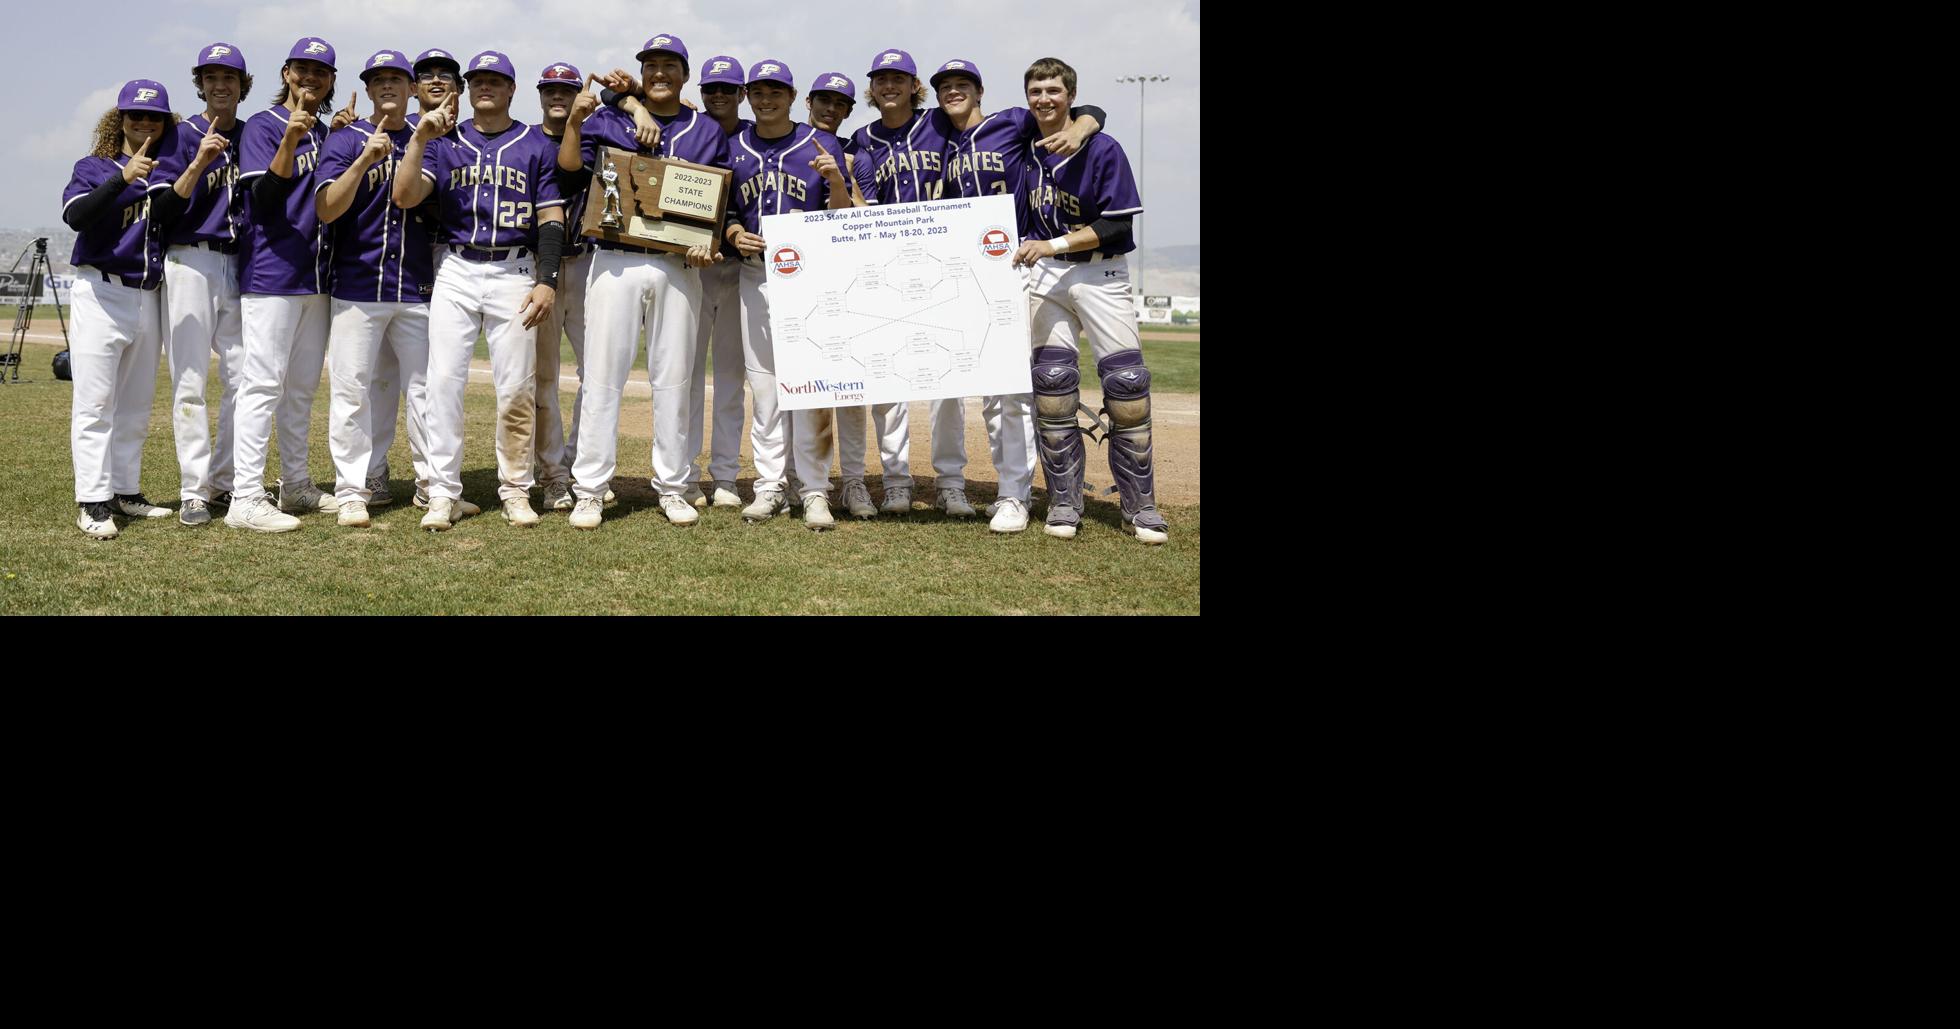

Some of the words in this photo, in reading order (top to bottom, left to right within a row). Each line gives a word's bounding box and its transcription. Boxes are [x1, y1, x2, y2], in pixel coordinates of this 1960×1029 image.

[303, 41, 329, 54] P
[649, 36, 672, 50] P
[207, 46, 232, 61] P
[372, 53, 395, 67] P
[879, 52, 903, 67] P
[476, 55, 500, 69] P
[709, 60, 732, 75] P
[757, 63, 781, 78] P
[825, 76, 849, 89] P
[133, 87, 159, 103] P
[947, 151, 1005, 182] IRATES
[449, 164, 527, 194] PIRATES
[674, 172, 713, 186] 2022-2023
[678, 186, 704, 197] STATE
[740, 170, 807, 206] PIRATES
[664, 196, 713, 212] CHAMPIONS
[1028, 185, 1081, 217] IRATES
[499, 200, 533, 229] 22
[804, 215, 825, 223] 2023
[826, 213, 848, 221] State
[850, 210, 861, 219] All
[863, 209, 885, 218] Class
[887, 205, 921, 216] Baseball
[922, 202, 972, 212] Tournament
[842, 222, 873, 232] Copper
[875, 217, 914, 228] Mountain
[916, 215, 935, 224] Park
[831, 235, 857, 243] Butte,
[858, 232, 872, 241] MT
[879, 231, 897, 240] May
[899, 228, 925, 238] 18-20,
[927, 226, 948, 235] 2023
[780, 379, 864, 395] NorthWestern
[834, 392, 864, 402] Energy
